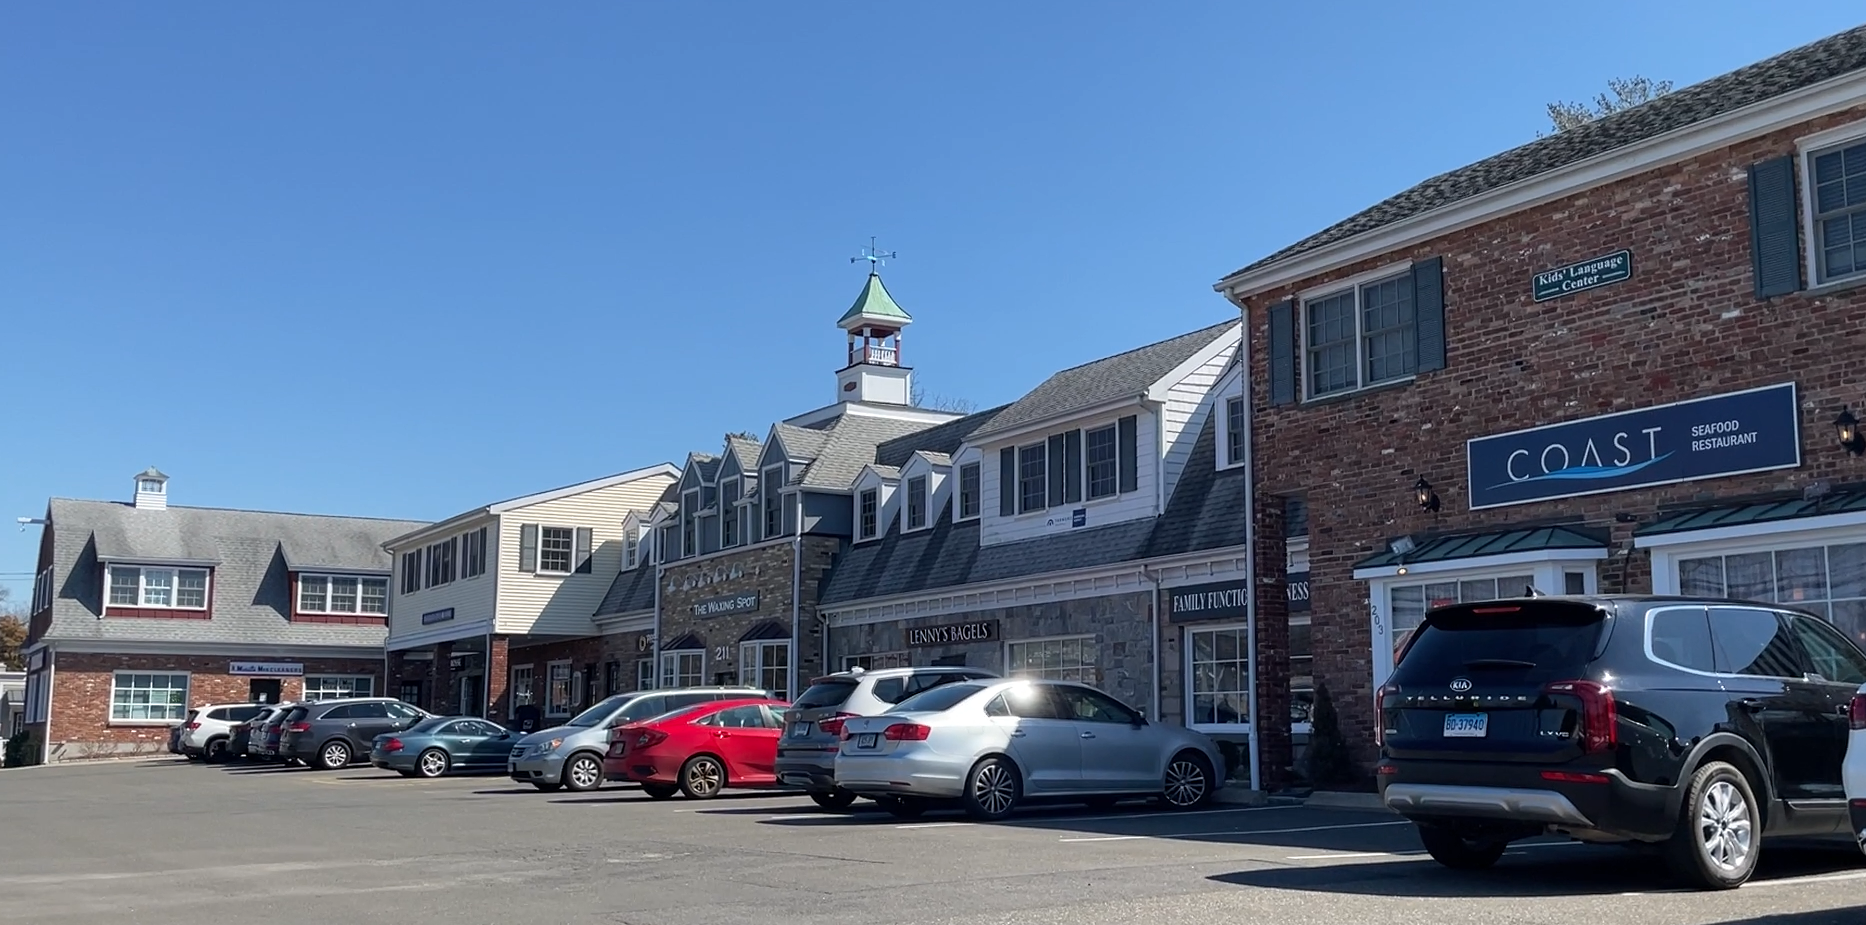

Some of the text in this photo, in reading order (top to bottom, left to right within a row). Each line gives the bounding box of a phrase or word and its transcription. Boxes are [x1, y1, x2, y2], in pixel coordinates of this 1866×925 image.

[1539, 256, 1624, 287] Kids' Language
[1561, 274, 1600, 292] Center
[1691, 420, 1740, 438] SEAFOOD
[1691, 432, 1758, 452] RESTAURANT
[1506, 426, 1662, 482] COAST
[693, 596, 756, 616] THE WAXING SPOT
[1173, 592, 1207, 613] FAMILY
[1371, 604, 1384, 636] 203
[909, 622, 989, 645] LENNY'S BAGELS
[715, 645, 730, 661] 211
